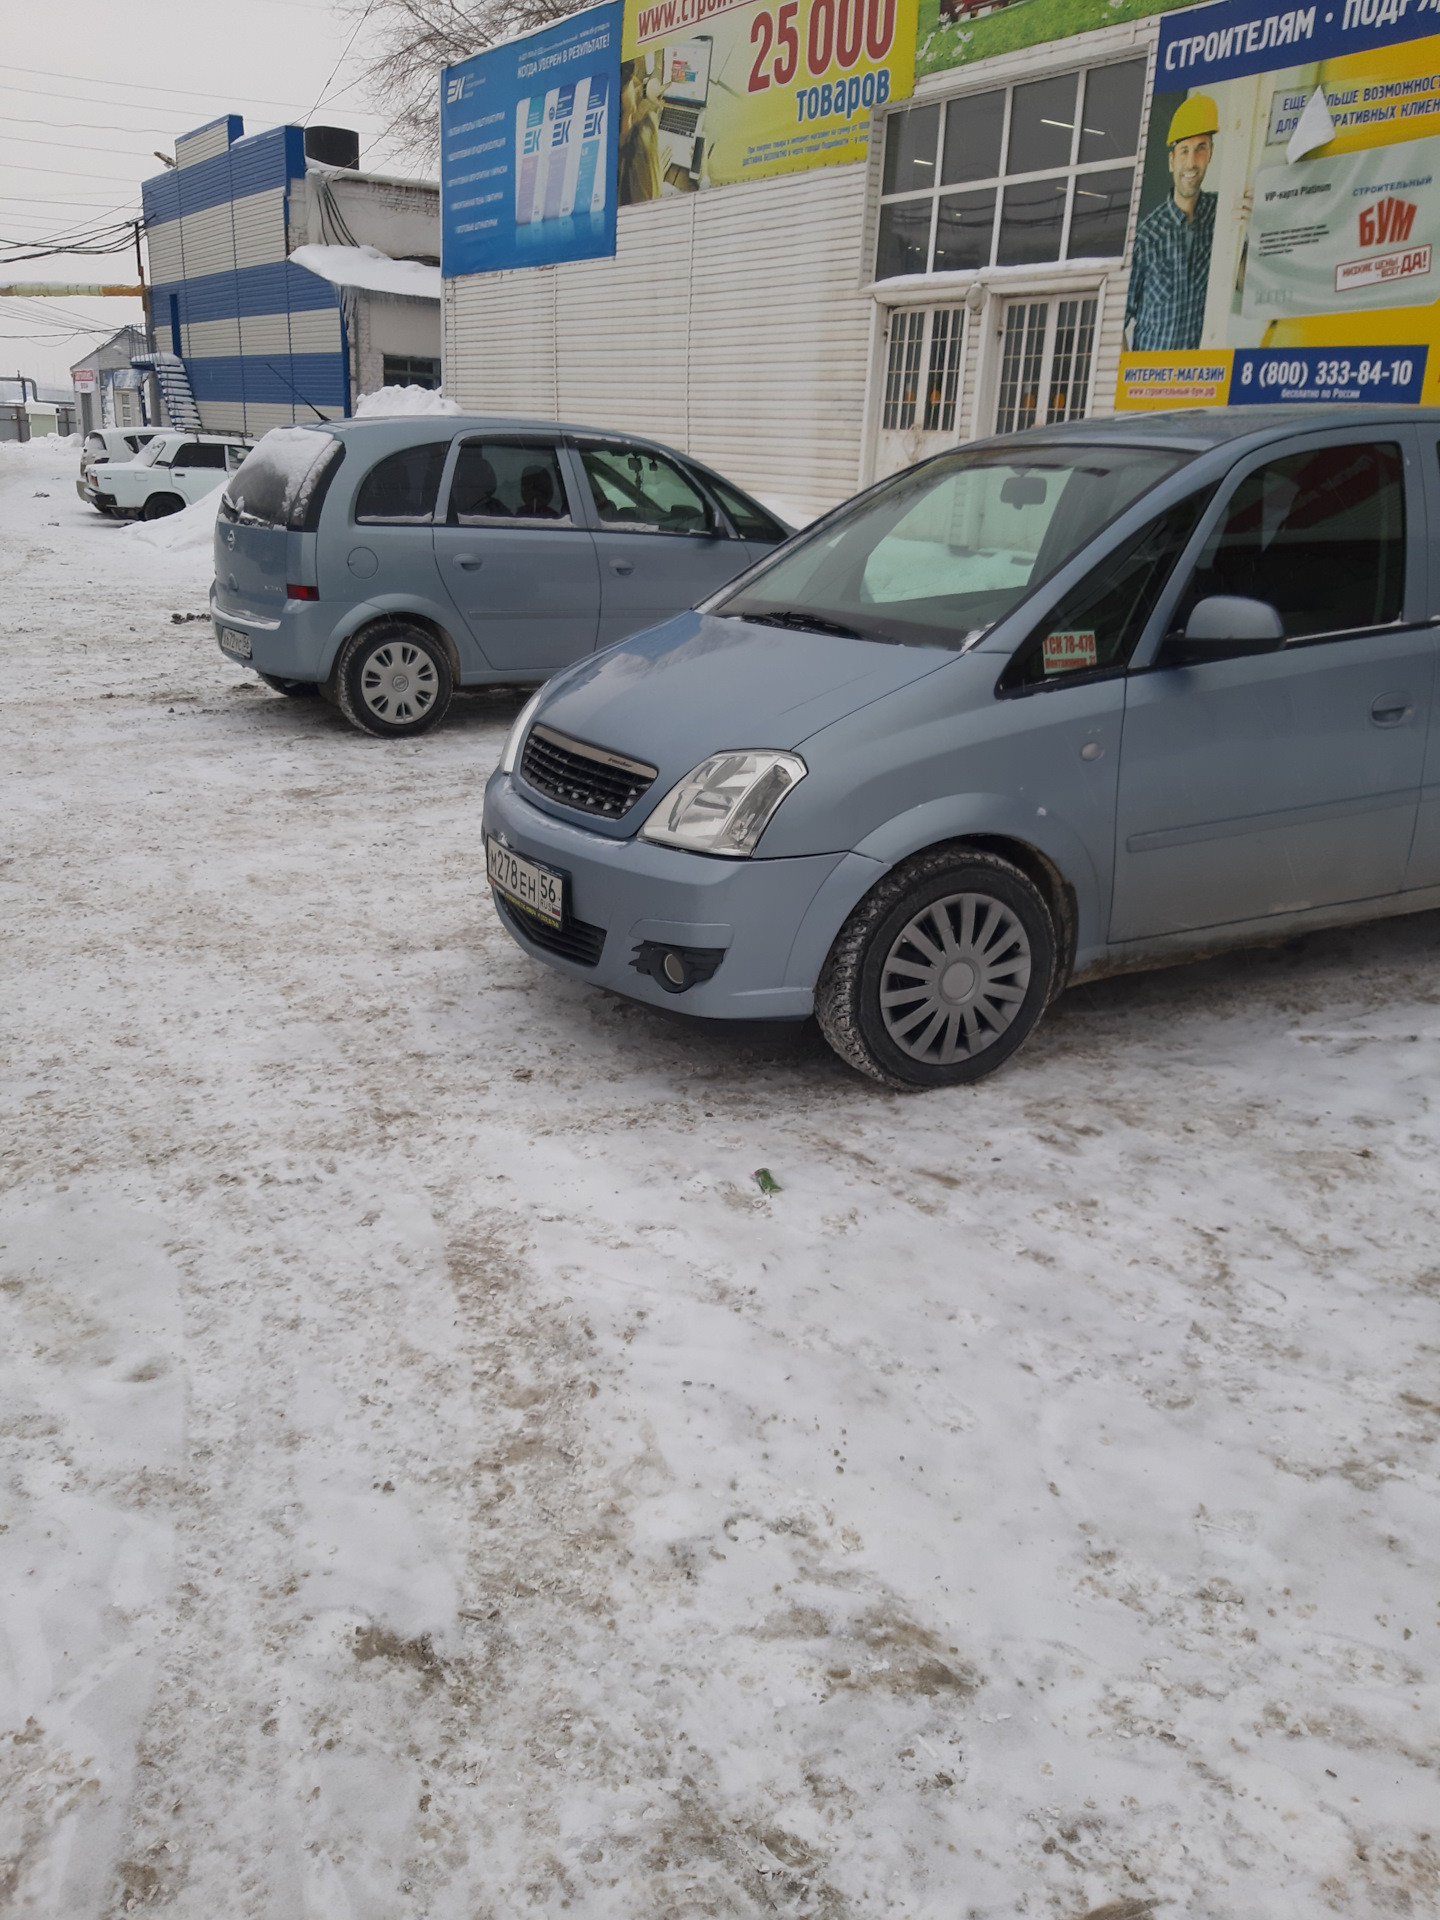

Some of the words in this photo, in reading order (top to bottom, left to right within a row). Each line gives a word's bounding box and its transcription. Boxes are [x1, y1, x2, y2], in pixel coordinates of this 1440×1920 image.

[539, 52, 561, 72] УВЕРЕН
[562, 49, 568, 63] В
[568, 33, 610, 61] РЕЗУЛЬТАТЕ!
[748, 2, 799, 93] 25
[807, 0, 896, 76] 000
[1164, 6, 1317, 71] СТРОИТЕЛЯМ
[796, 69, 890, 122] товаров
[1283, 94, 1307, 111] ЕЩЕ
[1322, 89, 1360, 107] ЛЬШЕ
[1363, 74, 1440, 102] ВОЗМОЖНОС
[1275, 117, 1299, 135] ДЛЯ
[1265, 188, 1299, 202] VIP-карта
[1300, 183, 1332, 196] Platinum
[1352, 175, 1433, 197] СТРОИТЕЛЬНЫЙ
[1359, 196, 1418, 247] БУМ
[1374, 256, 1399, 271] ЦЕНЫ
[1124, 367, 1225, 383] ИНТЕРНЕТ-МАГАЗИН
[1241, 362, 1253, 386] 8
[1259, 361, 1309, 388] (800)
[1315, 360, 1413, 386] 333-84-10
[1281, 388, 1320, 399] бесплатно
[1321, 389, 1332, 399] по
[1332, 388, 1361, 399] России
[540, 874, 556, 903] 56
